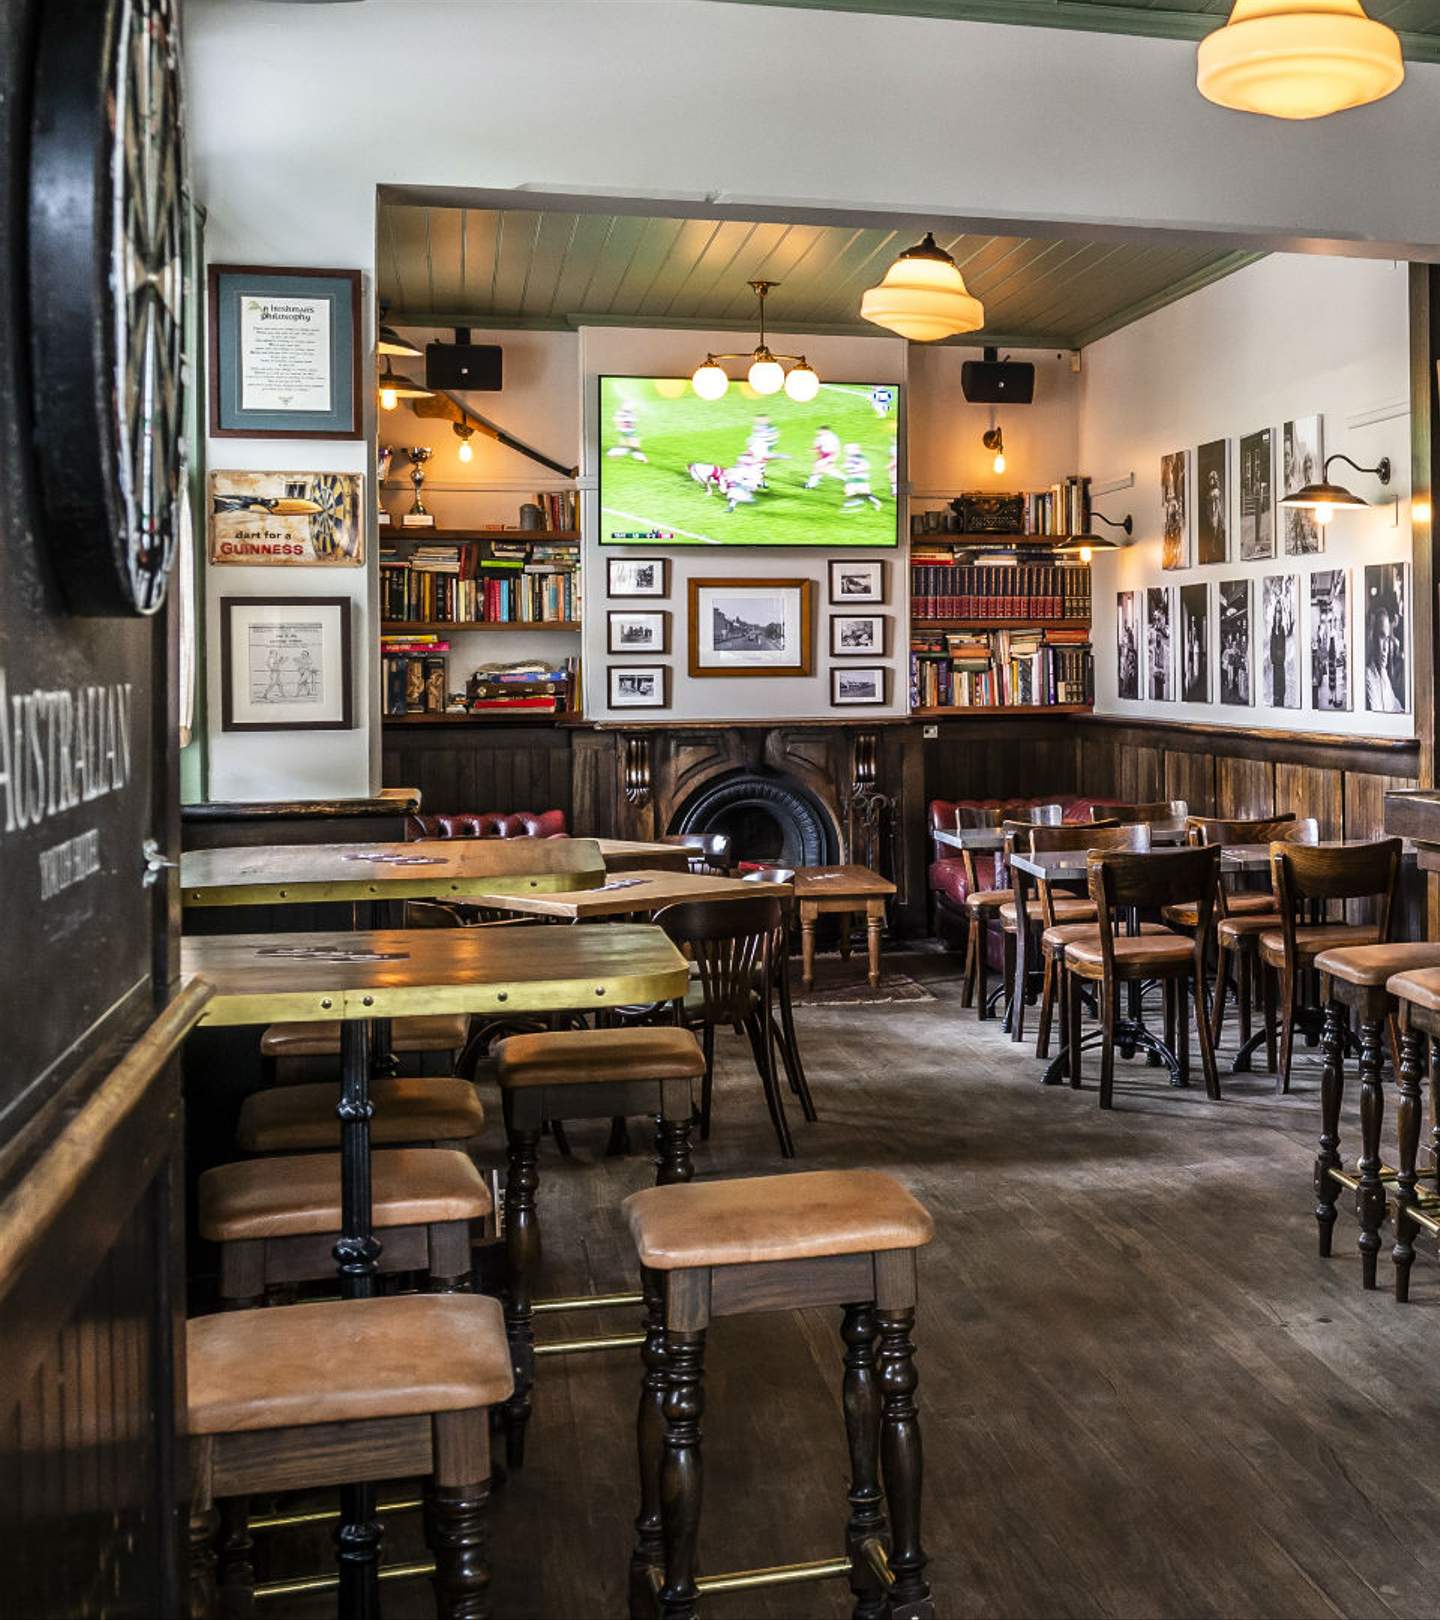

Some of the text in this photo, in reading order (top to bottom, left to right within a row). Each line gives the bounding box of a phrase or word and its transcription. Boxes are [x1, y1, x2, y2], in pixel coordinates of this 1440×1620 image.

[235, 530, 261, 539] dart
[264, 530, 282, 539] for
[220, 542, 304, 555] GUINNESS
